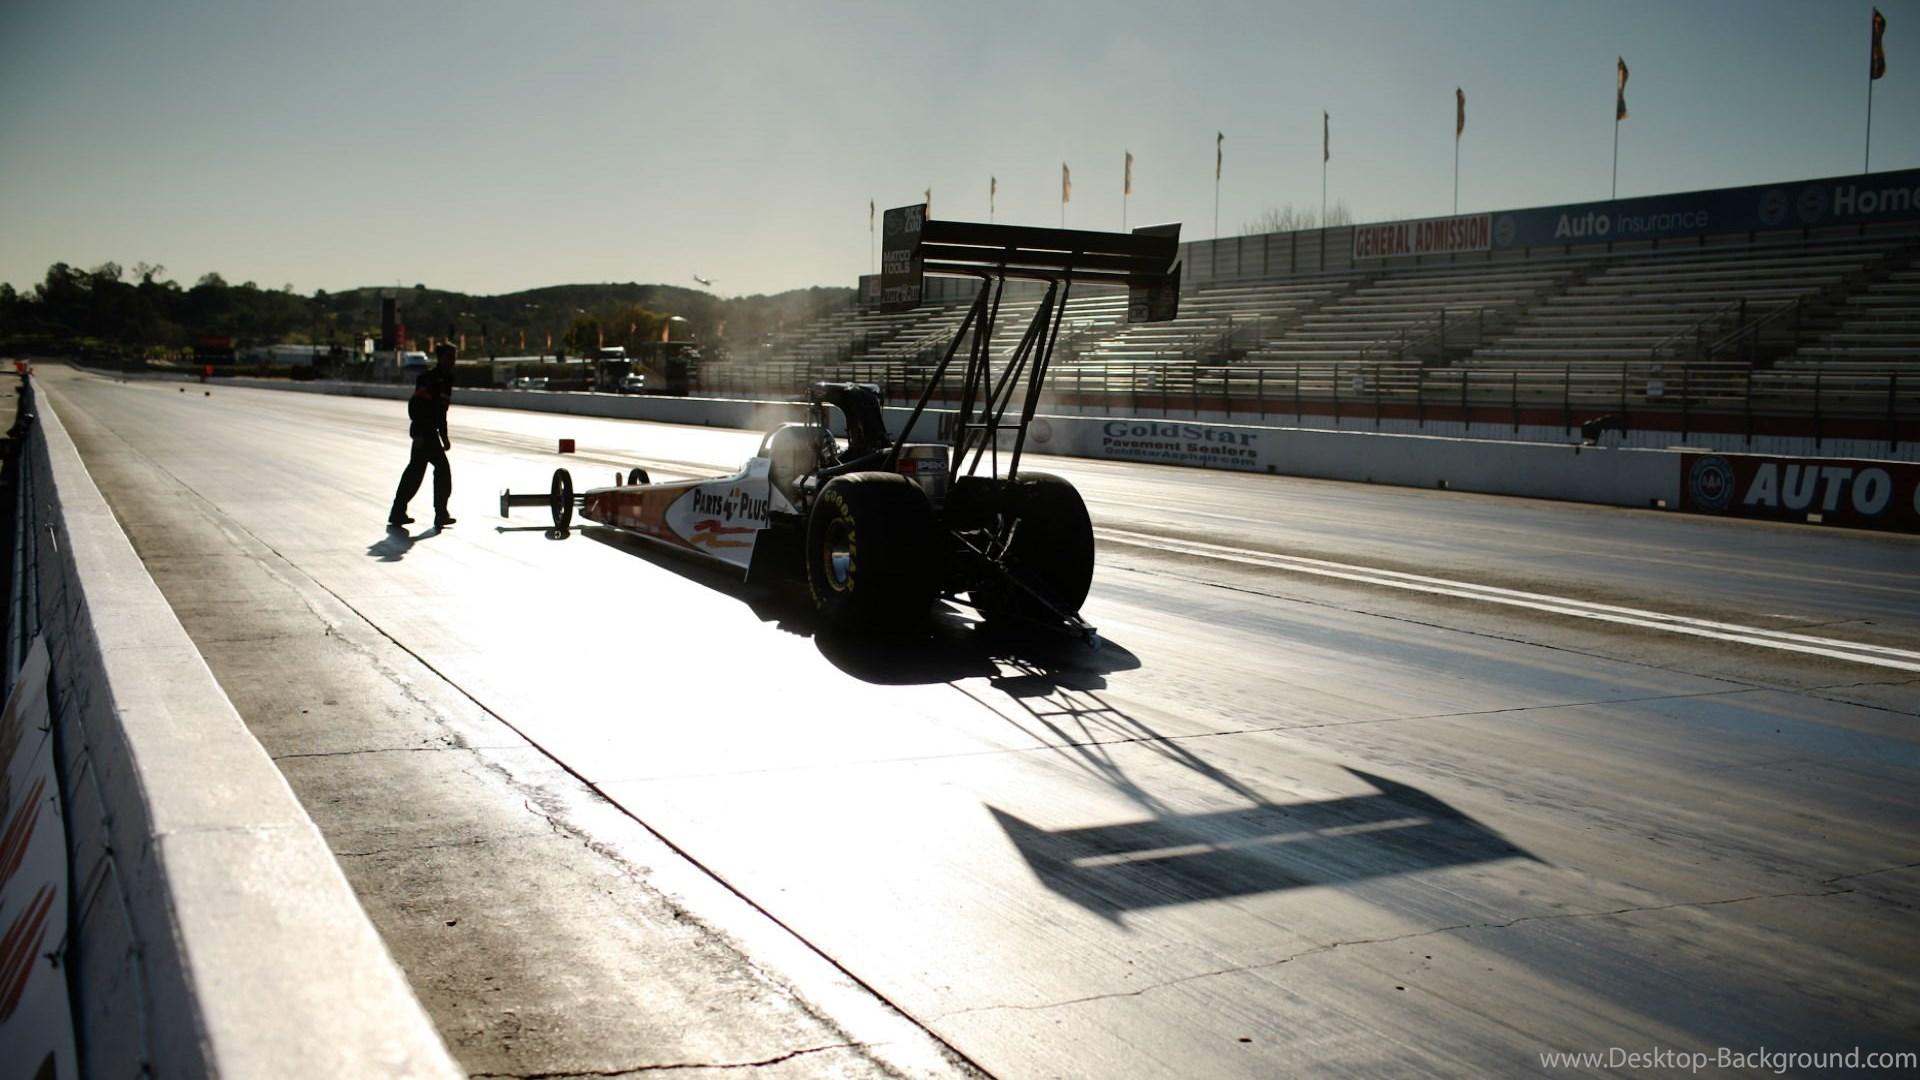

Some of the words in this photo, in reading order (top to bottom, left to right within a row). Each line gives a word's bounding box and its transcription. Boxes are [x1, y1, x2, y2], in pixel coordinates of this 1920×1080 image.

[1356, 224, 1410, 257] GENERAL
[1416, 216, 1489, 251] ADMISSION
[1554, 210, 1611, 239] Auto
[883, 261, 911, 274] TOOLS
[1103, 421, 1257, 446] GoldStar
[1103, 437, 1181, 451] Pavement
[1187, 443, 1257, 458] Sealers
[1743, 462, 1893, 516] AUTO
[693, 489, 722, 515] PARTS
[739, 492, 767, 521] PLUS
